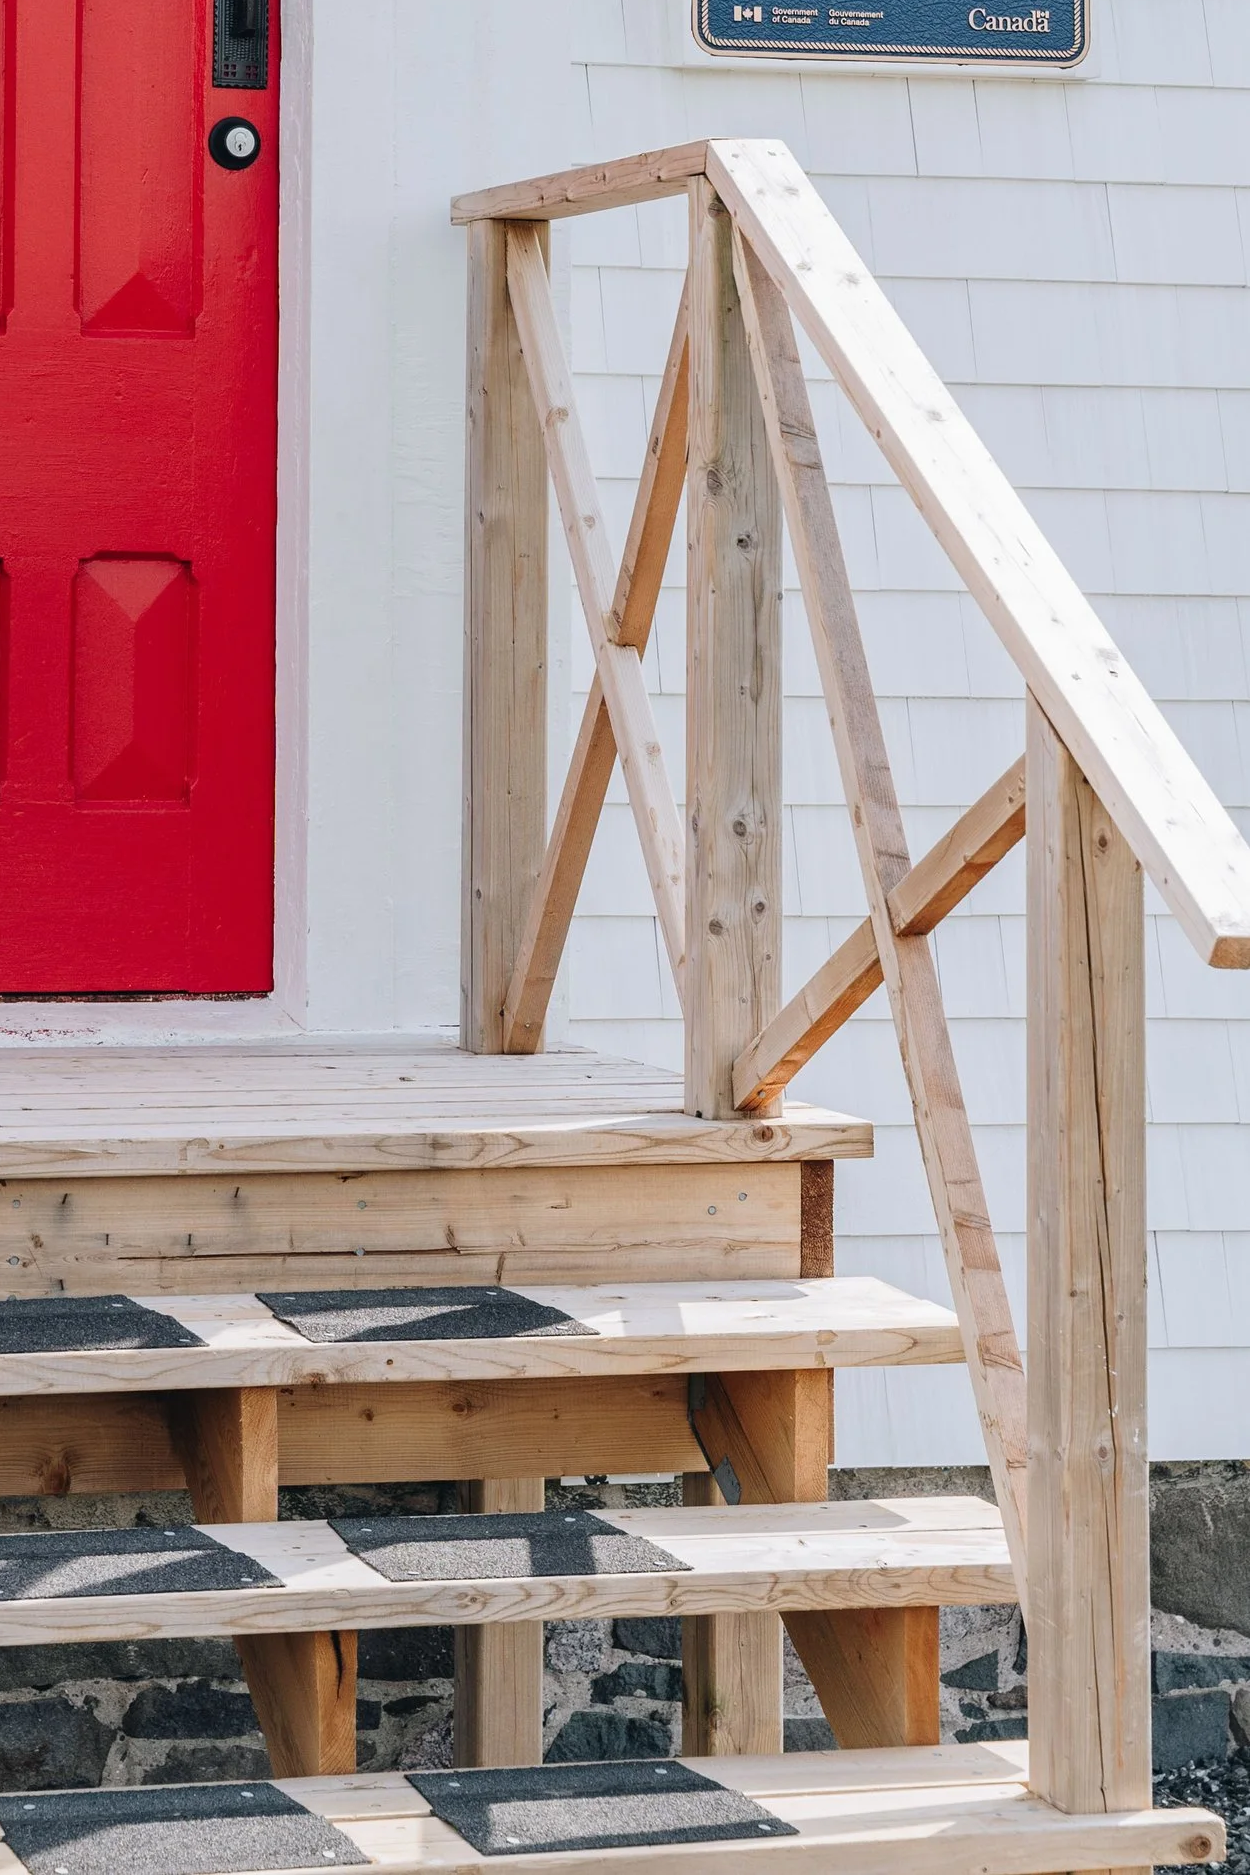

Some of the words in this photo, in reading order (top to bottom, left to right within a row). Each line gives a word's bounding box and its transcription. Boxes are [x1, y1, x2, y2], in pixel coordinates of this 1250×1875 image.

[772, 7, 819, 16] Government
[828, 9, 884, 19] Gouvernement
[772, 16, 781, 24] of
[782, 16, 811, 24] Canada
[828, 18, 839, 26] du
[840, 18, 870, 27] Canada
[968, 8, 1051, 33] Canada
